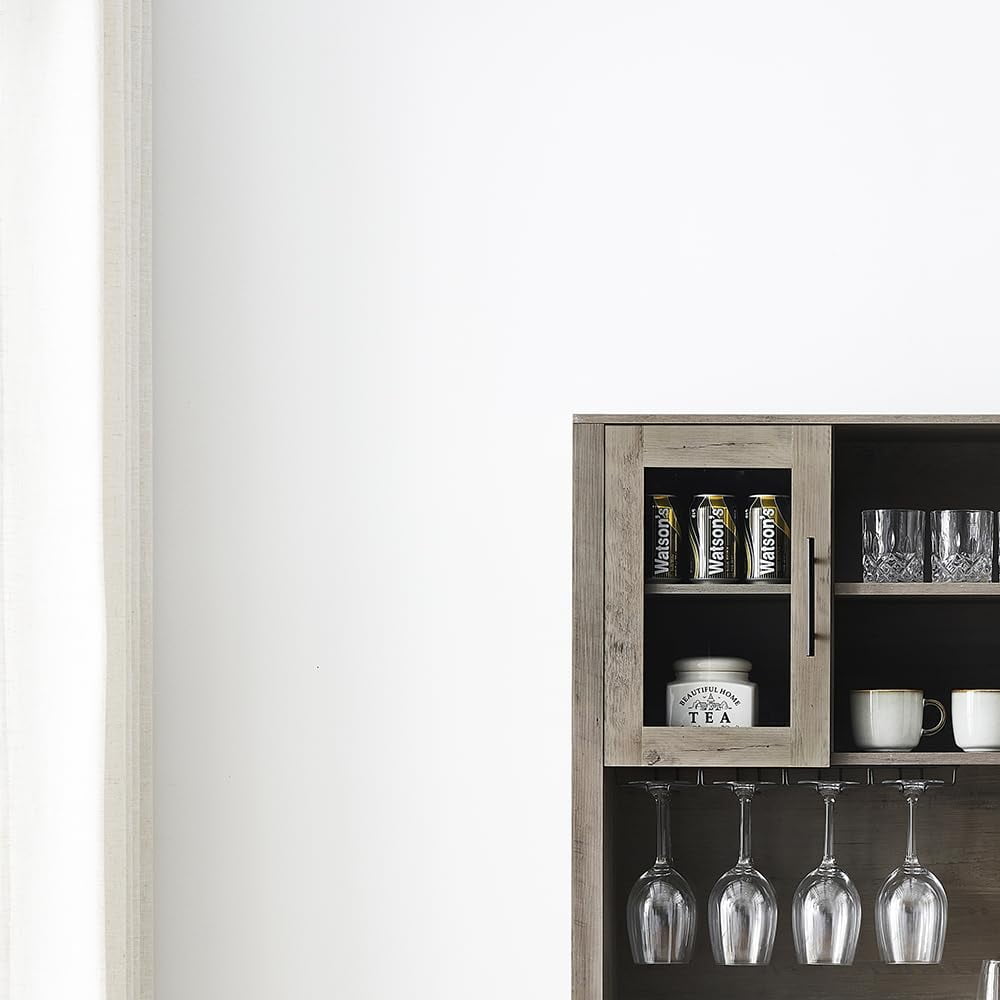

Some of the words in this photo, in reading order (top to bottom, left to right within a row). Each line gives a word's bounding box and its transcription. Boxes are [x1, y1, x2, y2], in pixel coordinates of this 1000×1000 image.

[654, 508, 670, 575] Watson's
[709, 508, 725, 576] Watson's
[760, 508, 776, 576] Watson's
[679, 686, 719, 706] BEAUTIFUL
[719, 688, 742, 706] HOME
[688, 711, 731, 724] TEA
